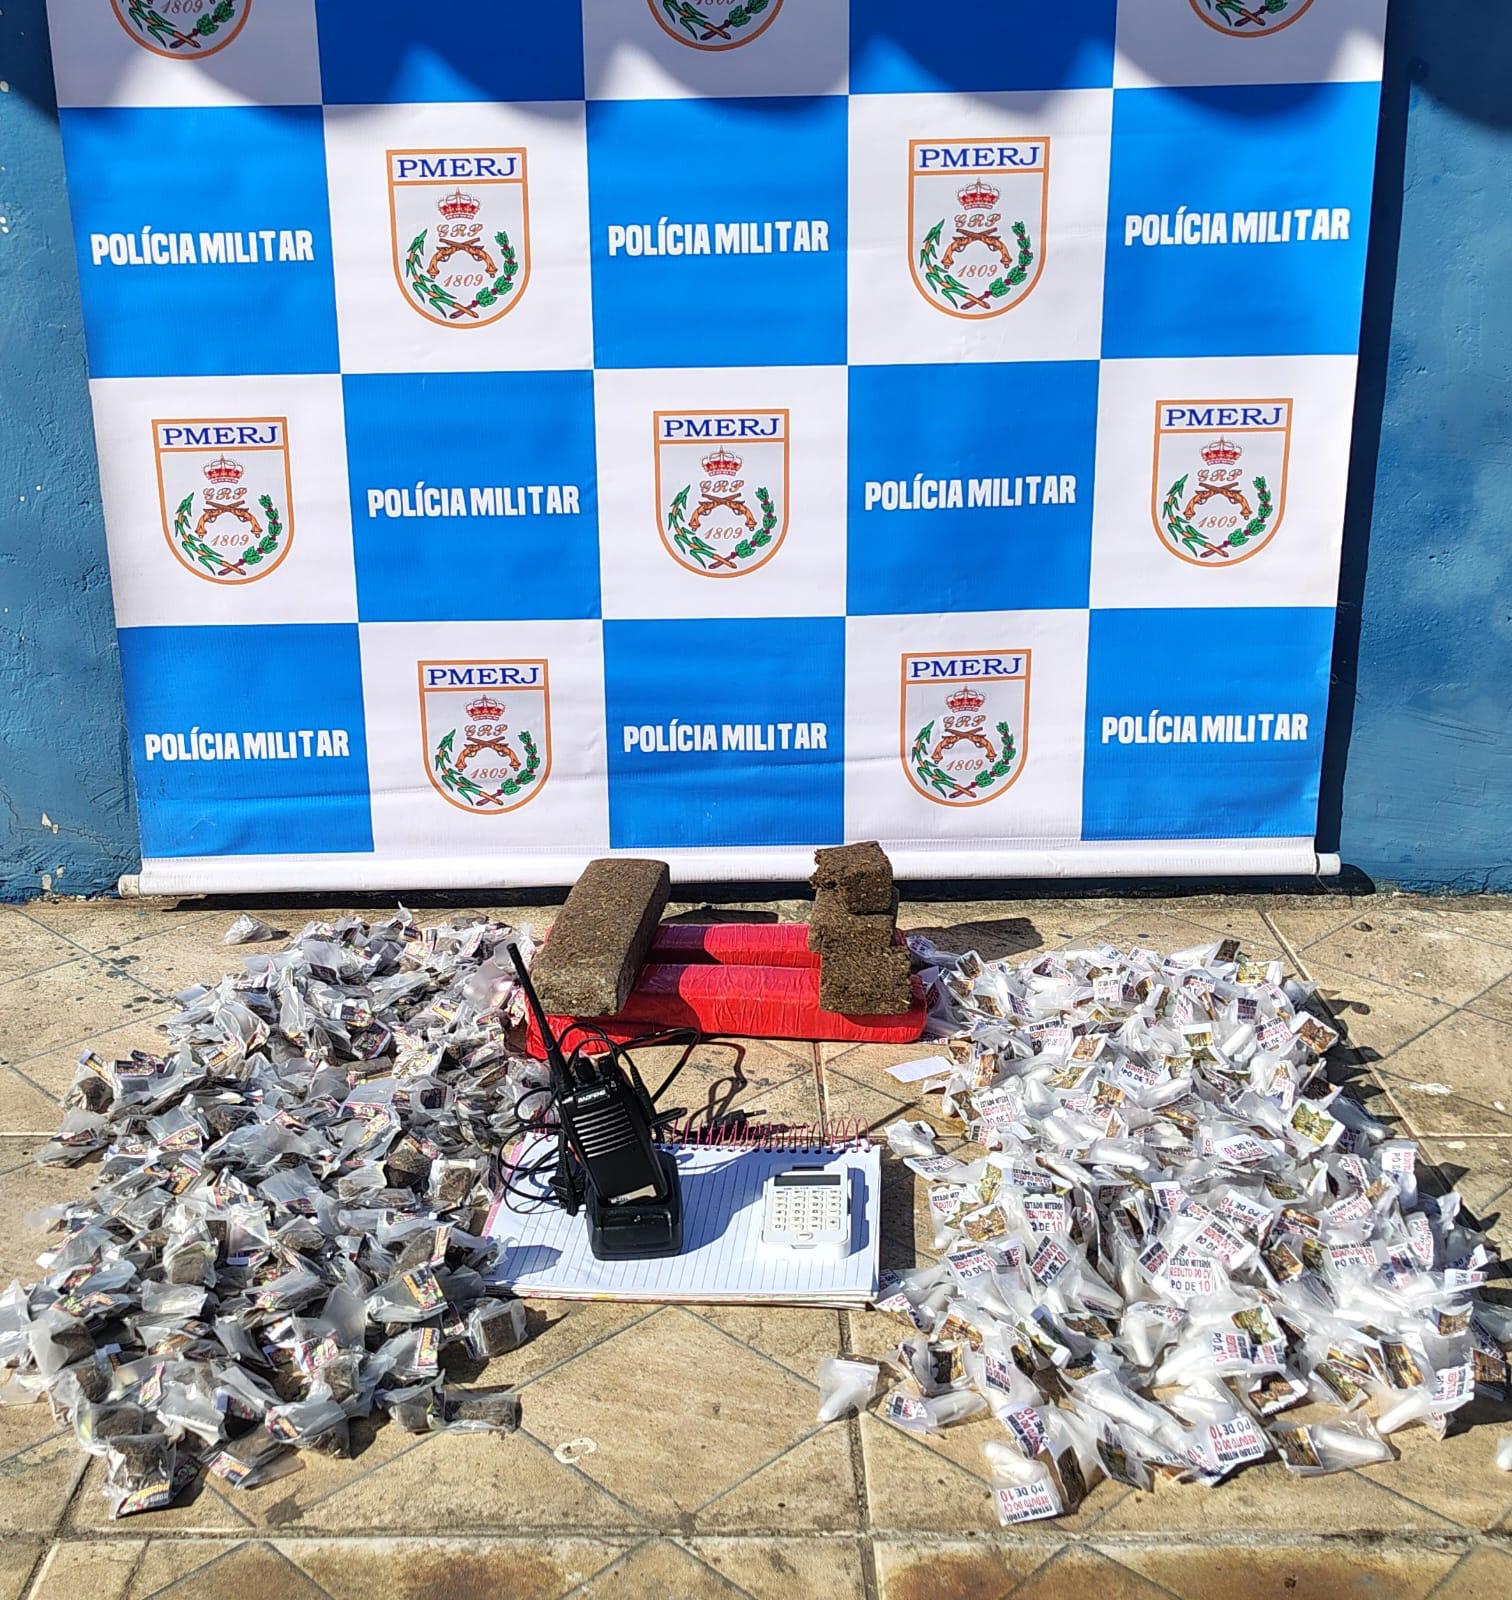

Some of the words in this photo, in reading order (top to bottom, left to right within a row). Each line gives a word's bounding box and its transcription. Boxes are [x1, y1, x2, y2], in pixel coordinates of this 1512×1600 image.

[918, 145, 1040, 169] PMERJ
[399, 156, 518, 178] PMERJ
[1125, 205, 1228, 246] POLÍCIA
[1231, 207, 1351, 244] MILITAR
[608, 217, 711, 257] POLÍCIA
[714, 220, 829, 255] MILITAR
[91, 226, 197, 266] POLÍCIA
[199, 229, 315, 264] MILITAR
[957, 263, 998, 278] 1809
[443, 273, 484, 288] 1809
[1166, 406, 1283, 428] PMERJ
[664, 415, 780, 438] PMERJ
[163, 425, 278, 446] PMERJ
[865, 473, 964, 511] POLÍCIA
[967, 475, 1077, 508] MILITAR
[368, 481, 467, 518] POLÍCIA
[469, 485, 580, 516] MILITAR
[1198, 515, 1238, 529] 1809
[210, 533, 250, 548] 1809
[704, 527, 743, 541] 1809
[911, 656, 1022, 678] PMERJ
[427, 667, 539, 686] PMERJ
[1102, 709, 1198, 744] POLÍCIA
[1201, 713, 1309, 743] MILITAR
[624, 718, 718, 753] POLÍCIA
[721, 723, 827, 751] MILITAR
[145, 727, 241, 761] POLÍCIA
[242, 729, 350, 760] MILITAR
[945, 758, 984, 771] 1809
[470, 767, 508, 779] 1809
[1221, 1197, 1234, 1206] 10
[1236, 1202, 1246, 1211] DE
[1040, 1222, 1050, 1231] DE
[1052, 1222, 1063, 1232] 10
[1048, 1261, 1059, 1274] DE
[1056, 1251, 1067, 1264] 10
[1170, 1258, 1189, 1266] ESTADO
[1349, 1257, 1361, 1265] DE
[1364, 1255, 1374, 1265] 10
[974, 1265, 985, 1274] DE
[1170, 1267, 1192, 1277] REDUTO
[1194, 1268, 1202, 1277] DO
[1203, 1268, 1211, 1279] CV
[1185, 1281, 1196, 1291] DE
[1199, 1280, 1211, 1293] 10
[1024, 1408, 1038, 1421] 10
[1209, 1425, 1222, 1439] 10
[1223, 1424, 1235, 1435] DE
[1214, 1441, 1222, 1453] CV
[1223, 1440, 1232, 1450] DO
[1231, 1435, 1256, 1449] REDUTO
[1239, 1445, 1261, 1457] ESTADO
[1000, 1489, 1014, 1502] 10
[1014, 1486, 1028, 1498] DE
[1003, 1503, 1013, 1513] CV
[1013, 1501, 1023, 1510] DO
[1024, 1495, 1049, 1508] REDUTO
[1030, 1505, 1053, 1516] ESTADO
